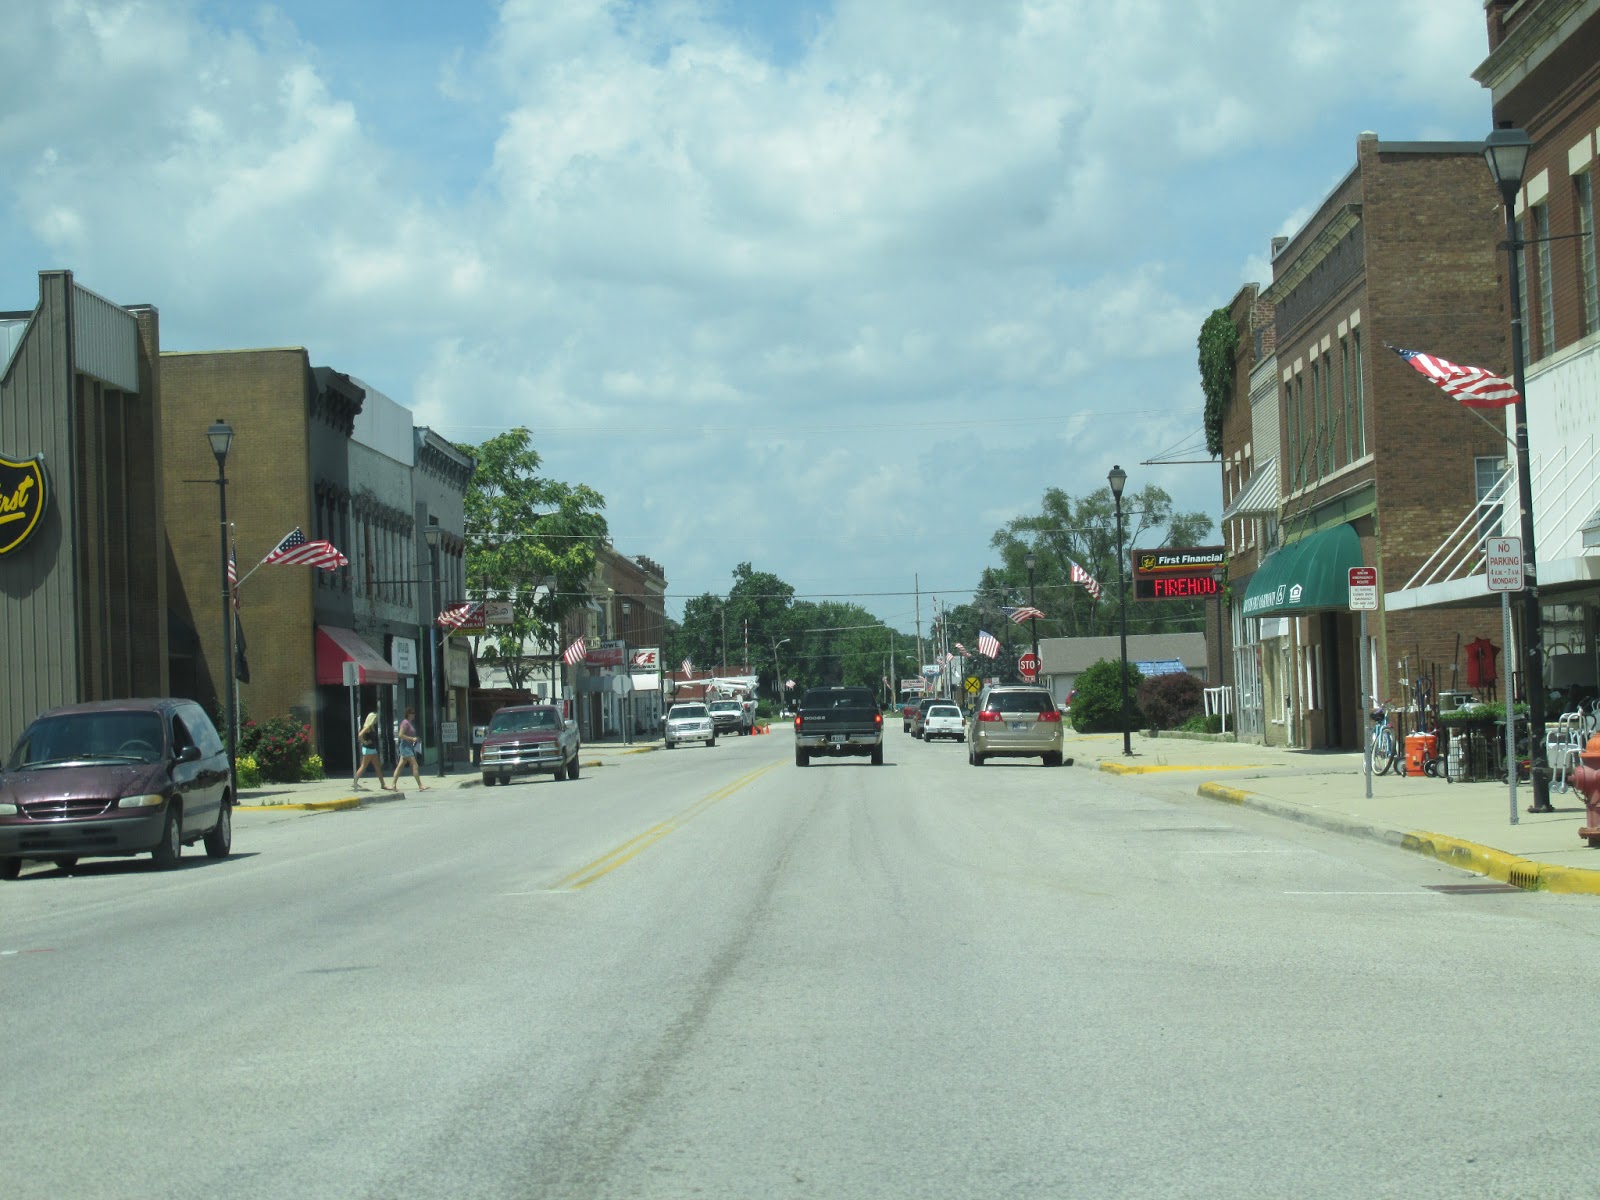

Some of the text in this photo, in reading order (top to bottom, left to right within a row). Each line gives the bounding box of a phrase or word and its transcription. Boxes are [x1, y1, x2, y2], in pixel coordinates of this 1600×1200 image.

[0, 475, 34, 513] rst
[1498, 544, 1510, 552] NO
[1158, 553, 1223, 564] First Financial
[1491, 556, 1519, 565] PARKING
